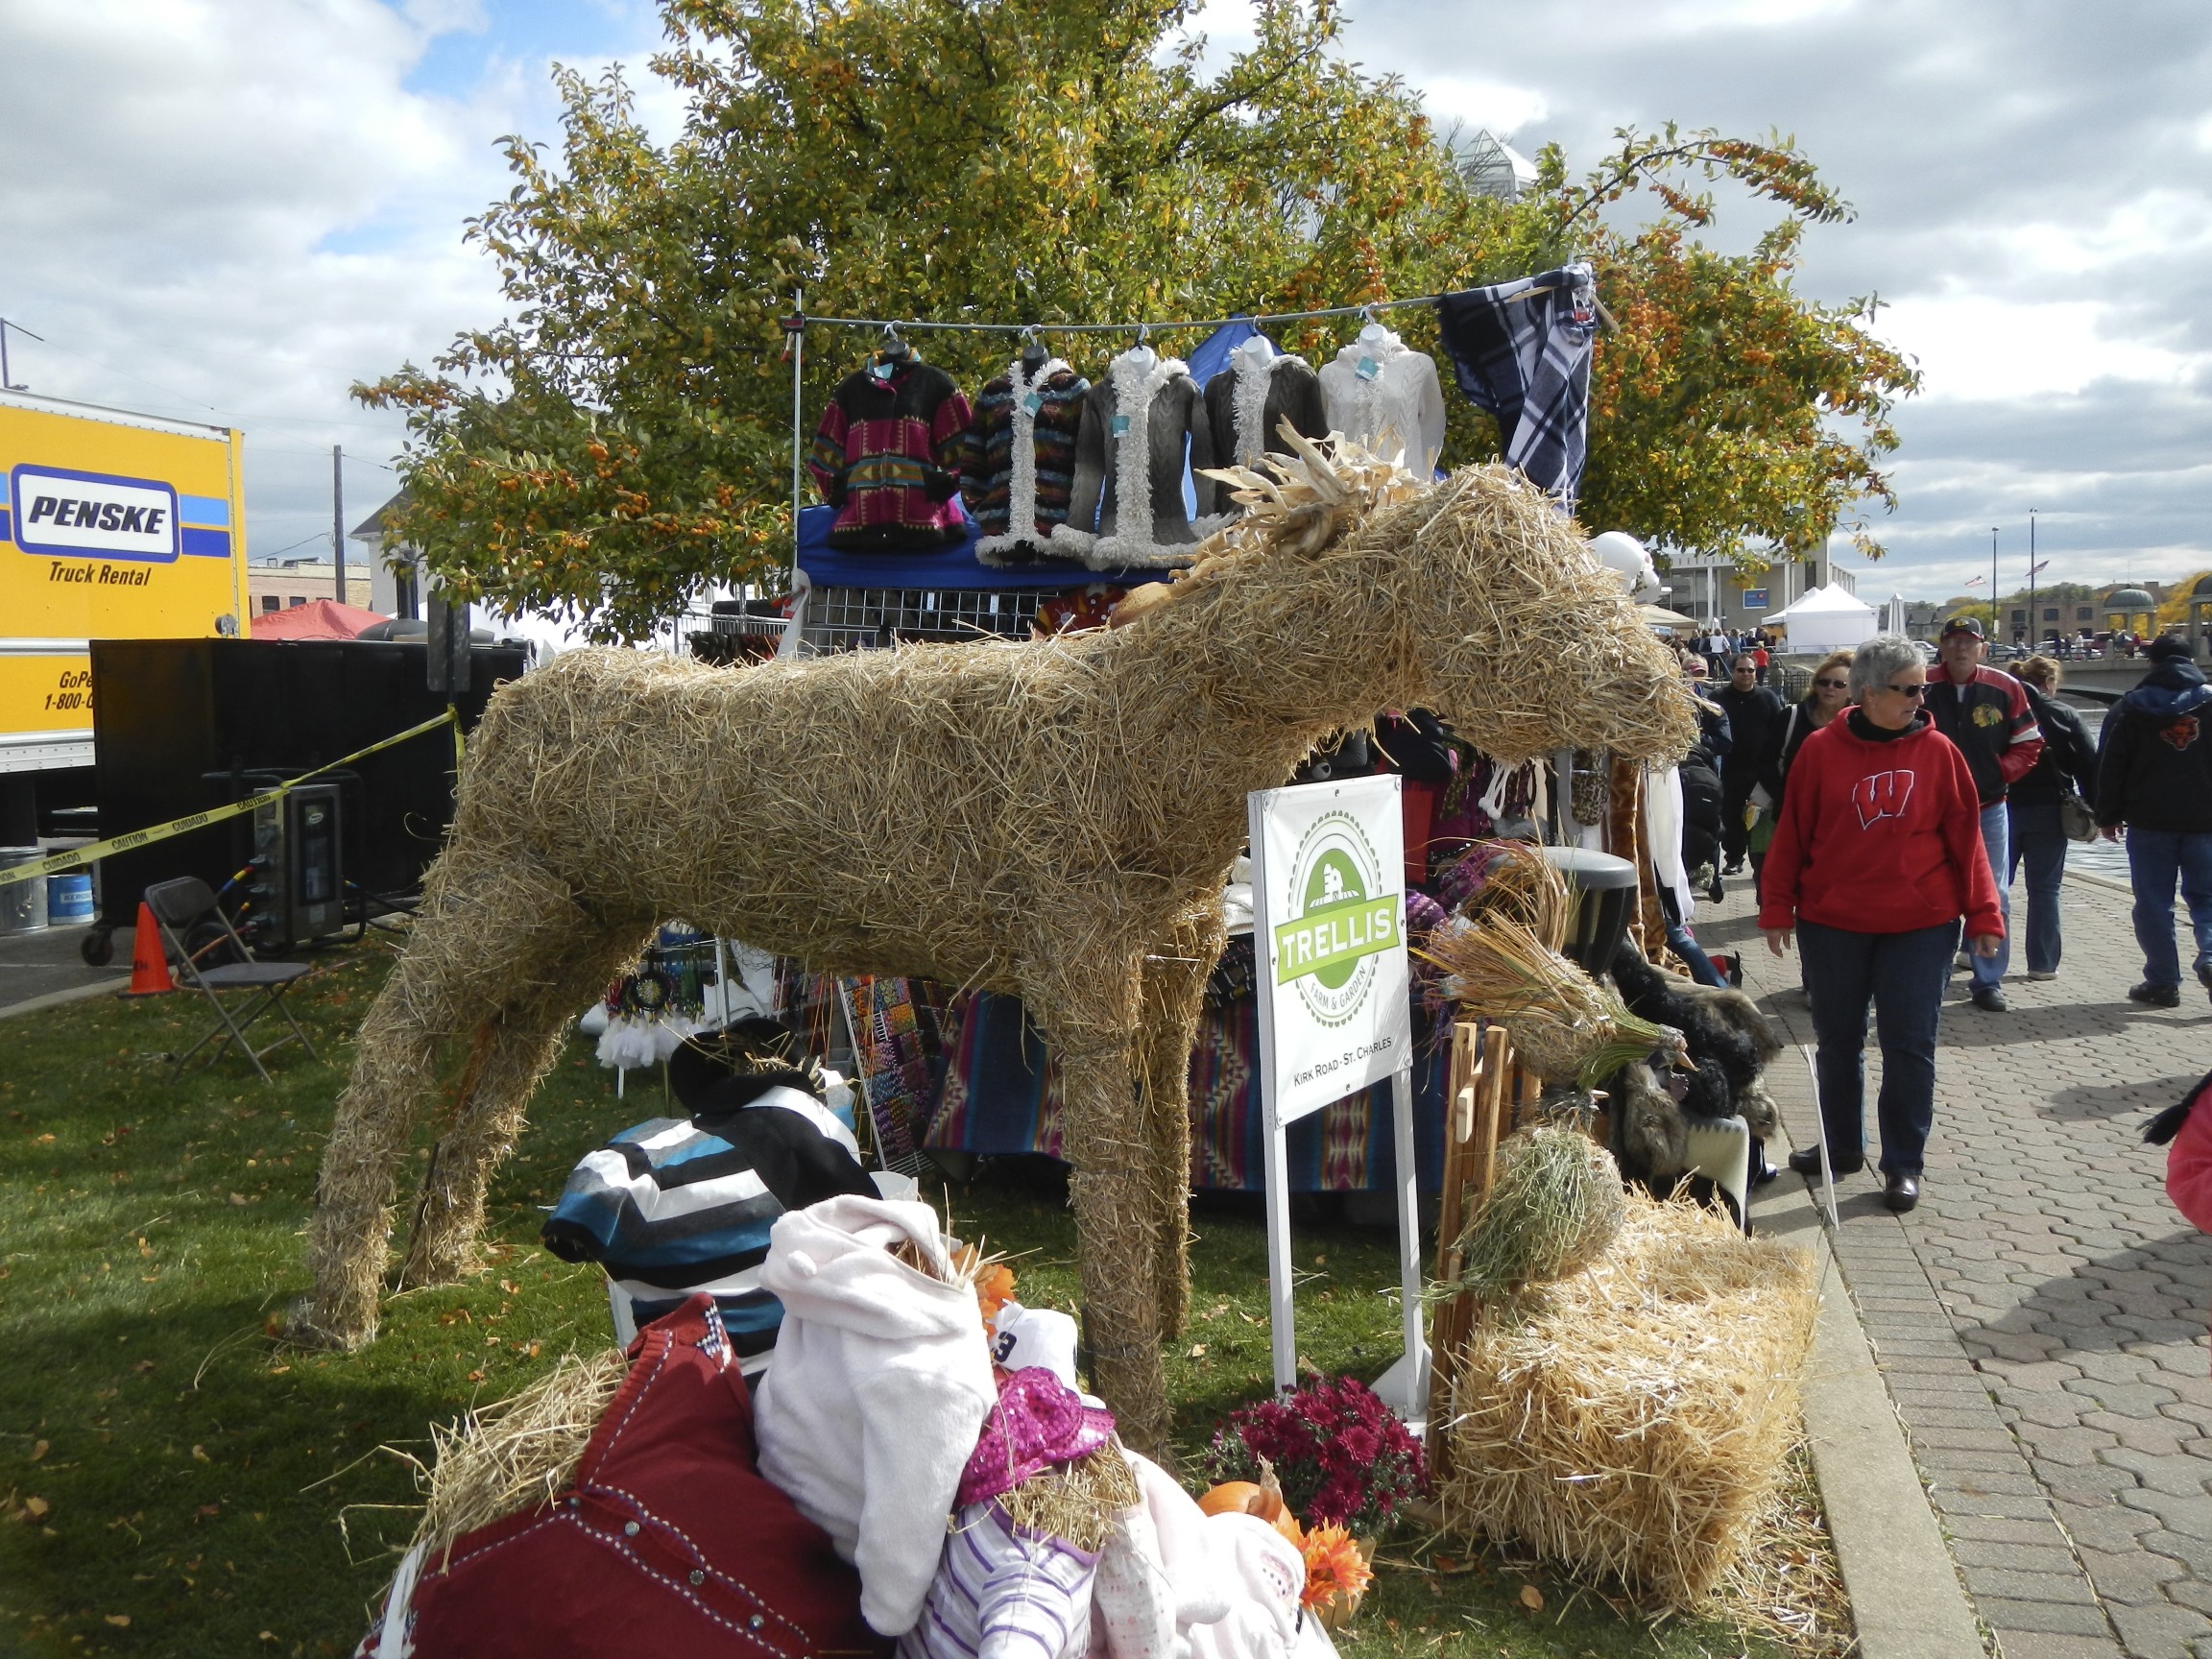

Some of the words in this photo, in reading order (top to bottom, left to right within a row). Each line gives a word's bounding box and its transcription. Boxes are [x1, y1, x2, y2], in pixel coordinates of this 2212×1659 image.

[28, 495, 166, 535] PENSKE
[49, 562, 96, 584] Truck
[98, 565, 152, 586] Rental
[1851, 769, 1914, 830] W
[42, 852, 82, 872] CUIDADO
[111, 831, 149, 851] CAUTION
[172, 813, 208, 832] CUIDADO
[1282, 908, 1392, 970] TRELLIS
[1310, 982, 1329, 1010] FARM
[1332, 997, 1337, 1010] &
[1339, 966, 1366, 1008] GARDEN
[1293, 1070, 1314, 1087] KIRK
[1357, 1037, 1392, 1060] CHARLES
